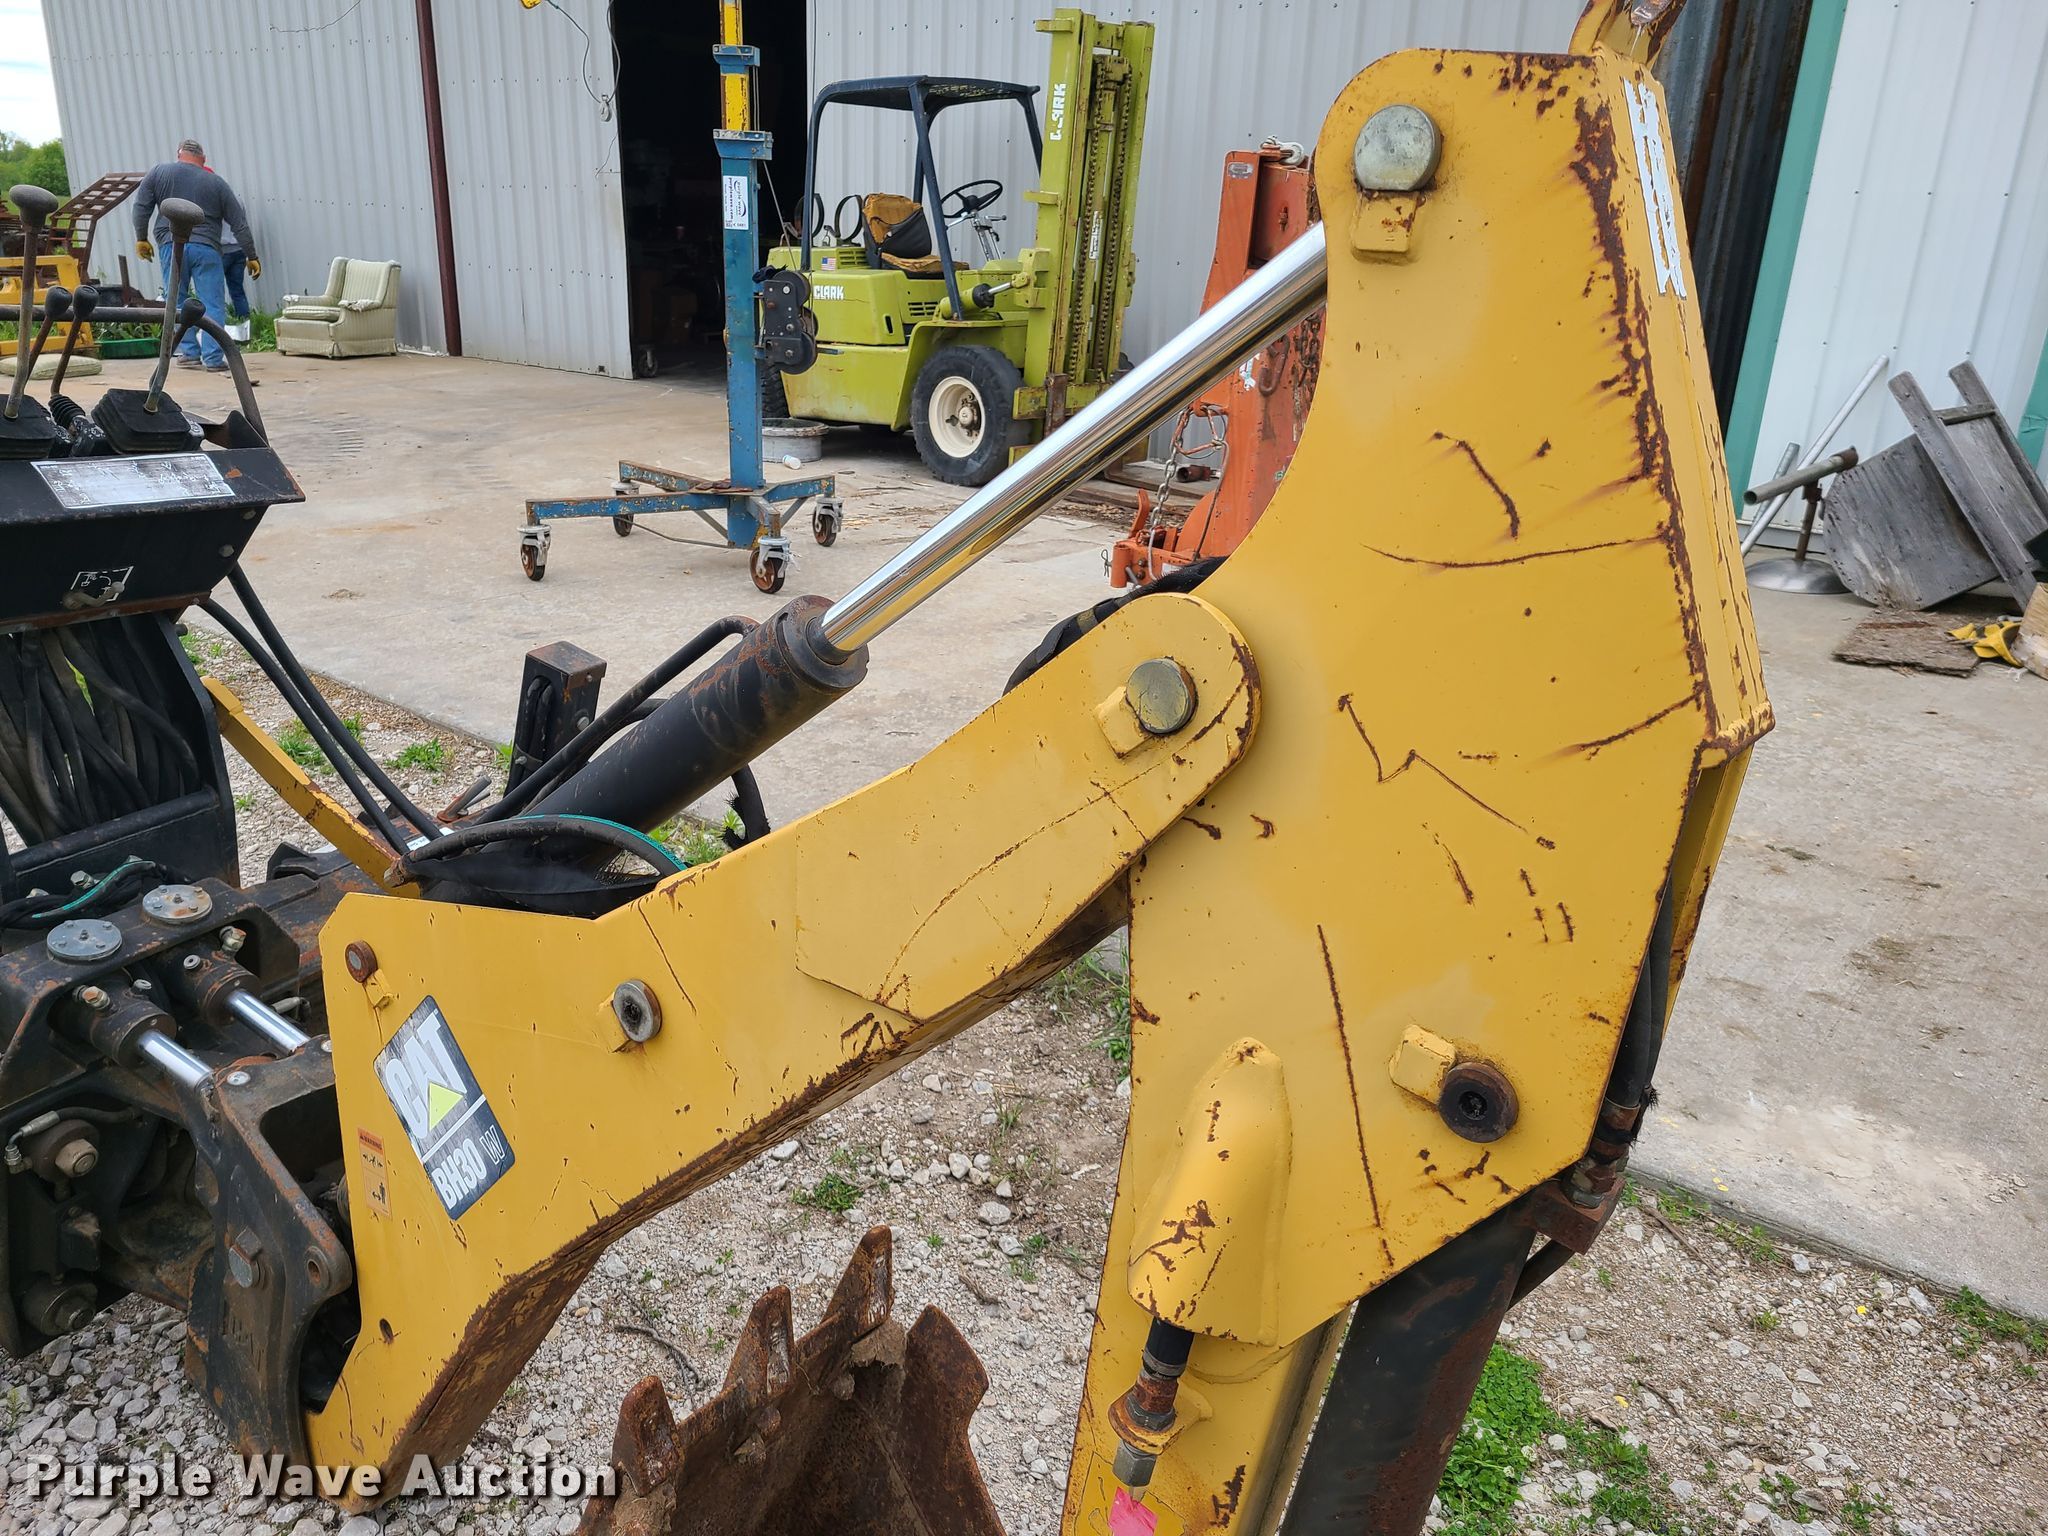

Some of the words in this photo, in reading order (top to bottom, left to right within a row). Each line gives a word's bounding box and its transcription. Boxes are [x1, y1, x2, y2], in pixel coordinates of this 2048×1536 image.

[813, 285, 844, 300] CLARK
[385, 1011, 467, 1139] CAT
[431, 1138, 487, 1210] BH30
[479, 1124, 505, 1165] W
